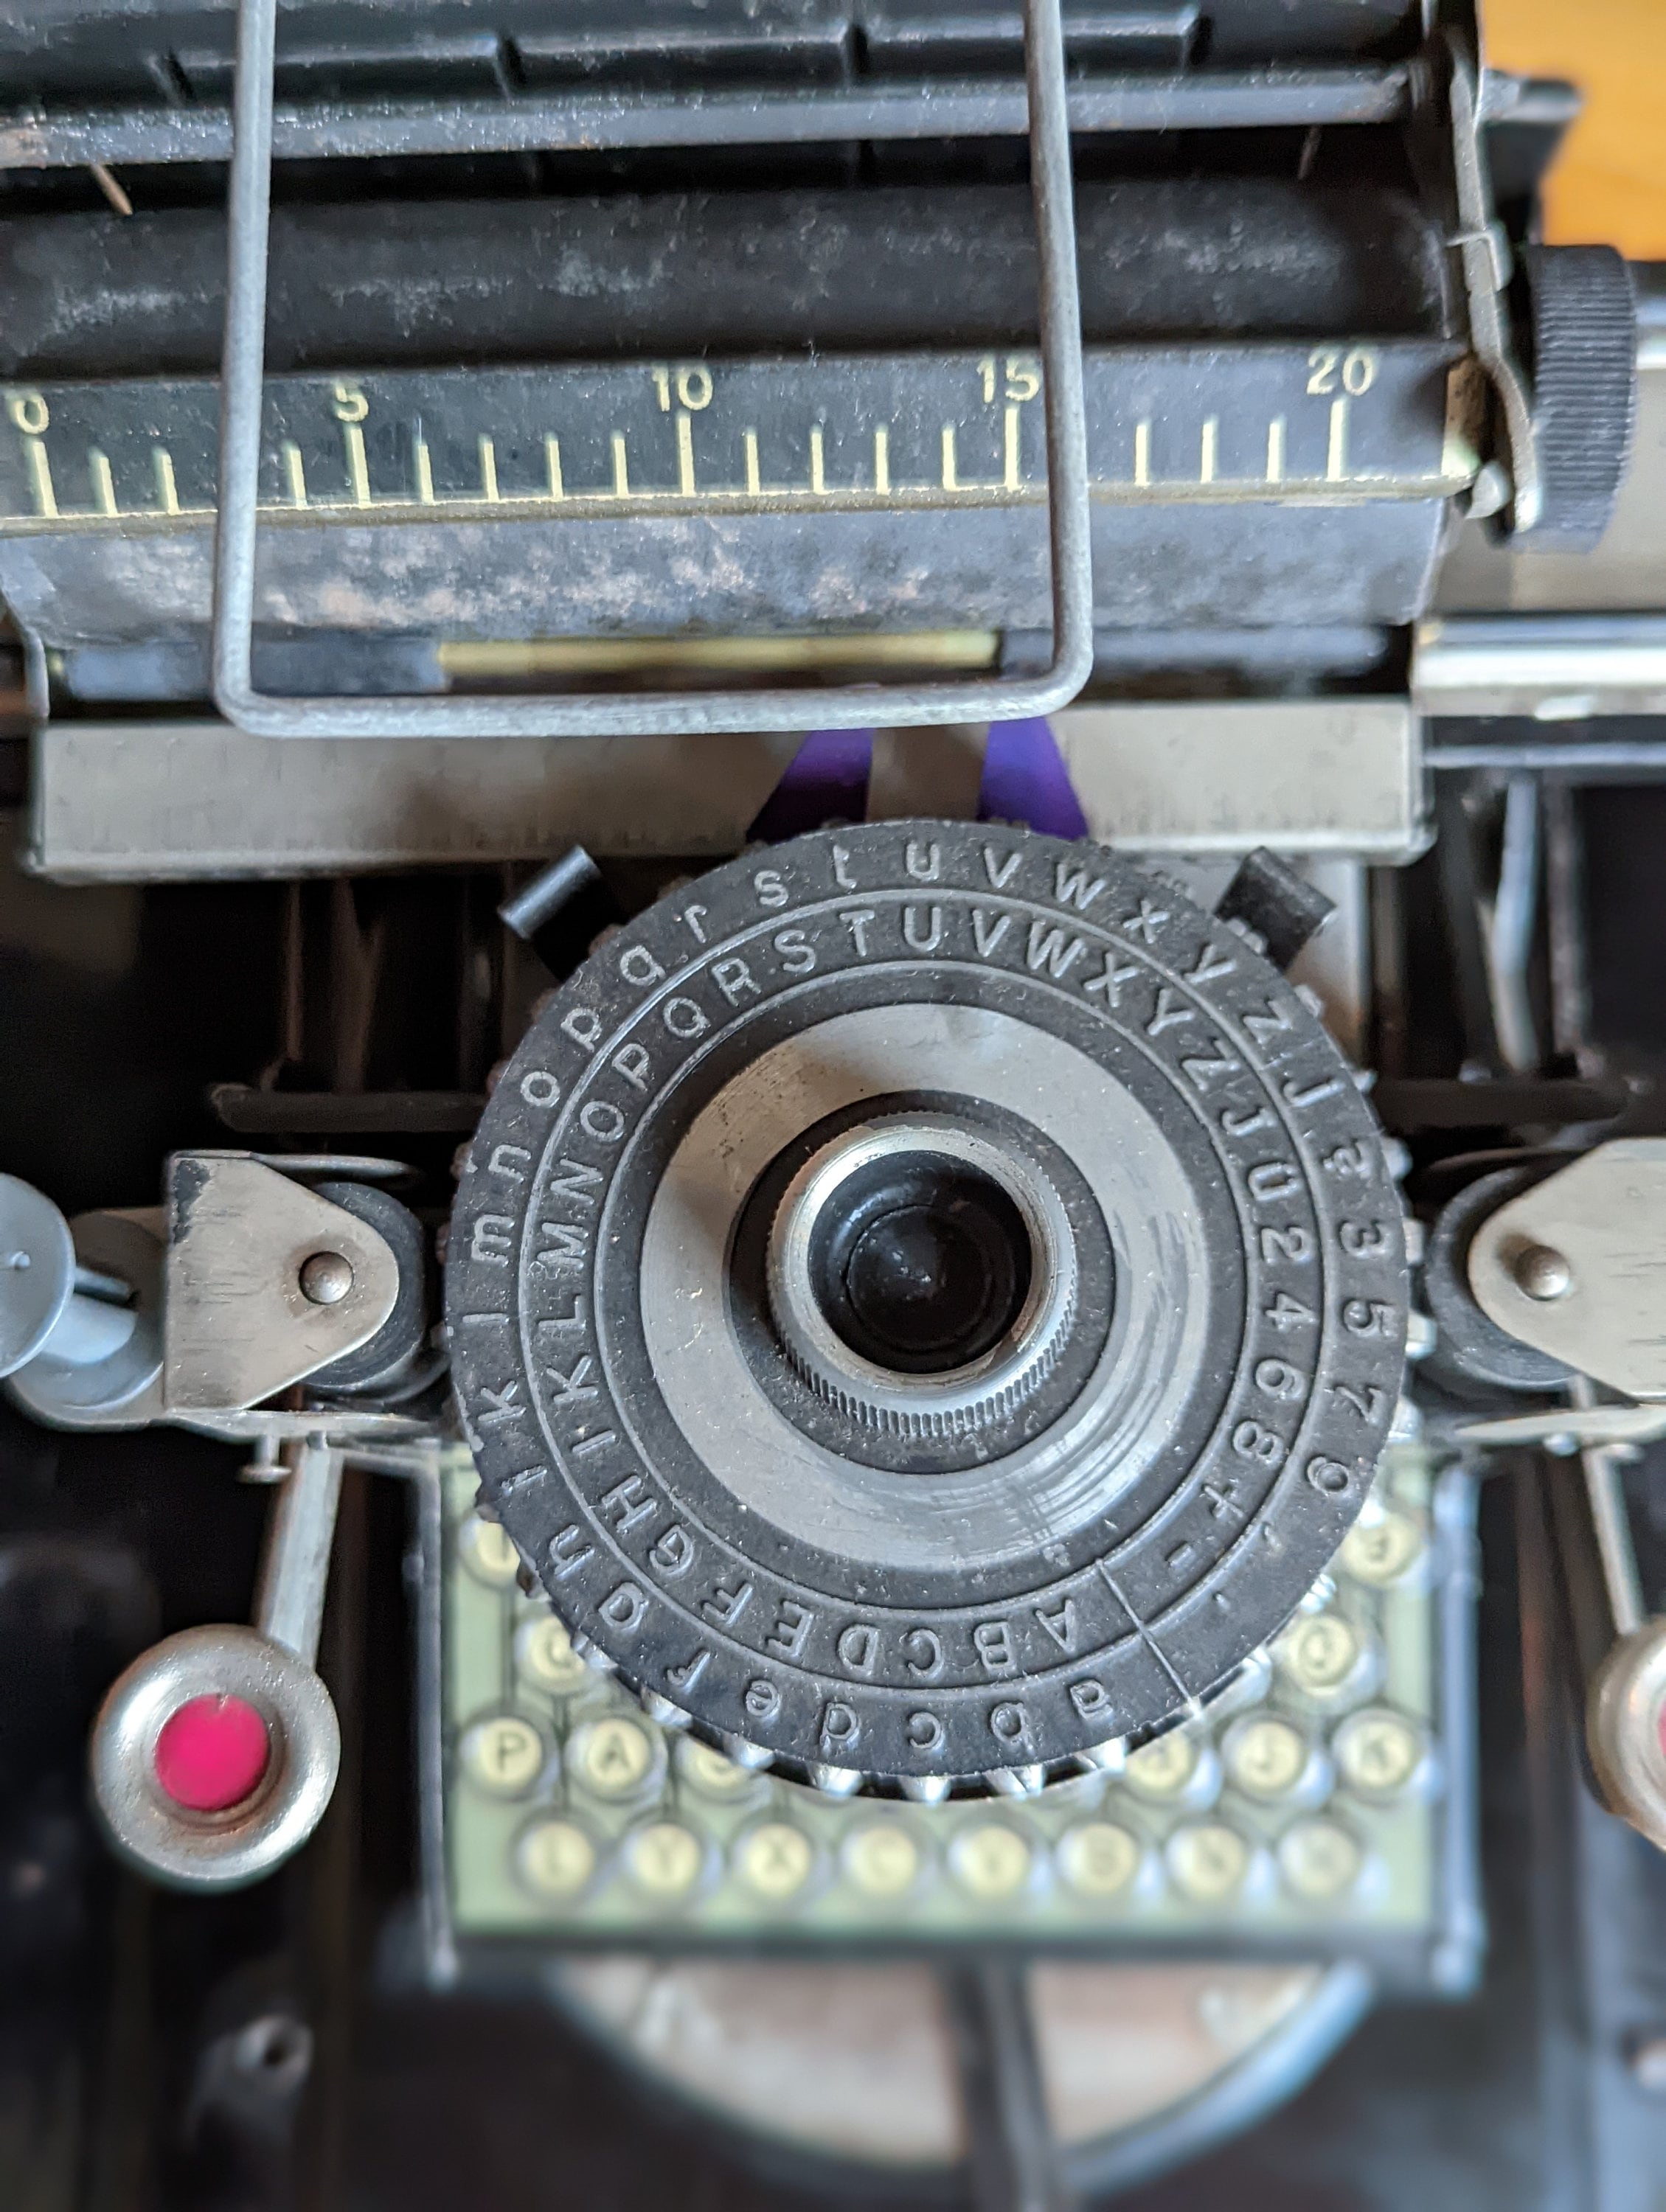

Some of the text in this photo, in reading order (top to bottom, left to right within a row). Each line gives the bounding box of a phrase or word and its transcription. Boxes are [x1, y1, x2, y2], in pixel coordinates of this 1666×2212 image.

[13, 347, 1373, 434] 0 5 10 15 20
[905, 844, 940, 880] u
[840, 909, 875, 956] T
[903, 907, 943, 950] U
[973, 911, 1011, 957] V
[619, 946, 665, 986] q
[774, 931, 816, 973] S
[1027, 929, 1086, 977] W
[712, 958, 762, 1006] R
[1084, 953, 1138, 1007] X
[664, 998, 711, 1037] Q
[1148, 990, 1193, 1035] Y
[611, 1043, 652, 1091] P
[1182, 1040, 1241, 1090] Z
[581, 1101, 625, 1141] O
[1222, 1110, 1276, 1136] J
[488, 1145, 531, 1182] n
[550, 1159, 603, 1204] N
[471, 1214, 514, 1267] m
[538, 1222, 589, 1268] M
[1260, 1227, 1312, 1265] 2
[1339, 1219, 1386, 1259] 3
[538, 1295, 586, 1329] L
[1265, 1293, 1318, 1340] 4
[1343, 1300, 1396, 1338] 5
[546, 1356, 598, 1402] K
[1256, 1358, 1308, 1399] 6
[1233, 1420, 1283, 1464] 8
[602, 1477, 657, 1529] H
[650, 1526, 694, 1575] G
[703, 1584, 753, 1624] F
[1035, 1599, 1077, 1651] A
[767, 1601, 813, 1658] E
[838, 1625, 882, 1675] D
[903, 1628, 943, 1675] C
[975, 1622, 1013, 1669] B
[746, 1679, 781, 1717] e
[1070, 1679, 1111, 1719] a
[821, 1703, 861, 1746] d
[991, 1703, 1032, 1746] b
[496, 1733, 528, 1773] P
[601, 1732, 633, 1773] A
